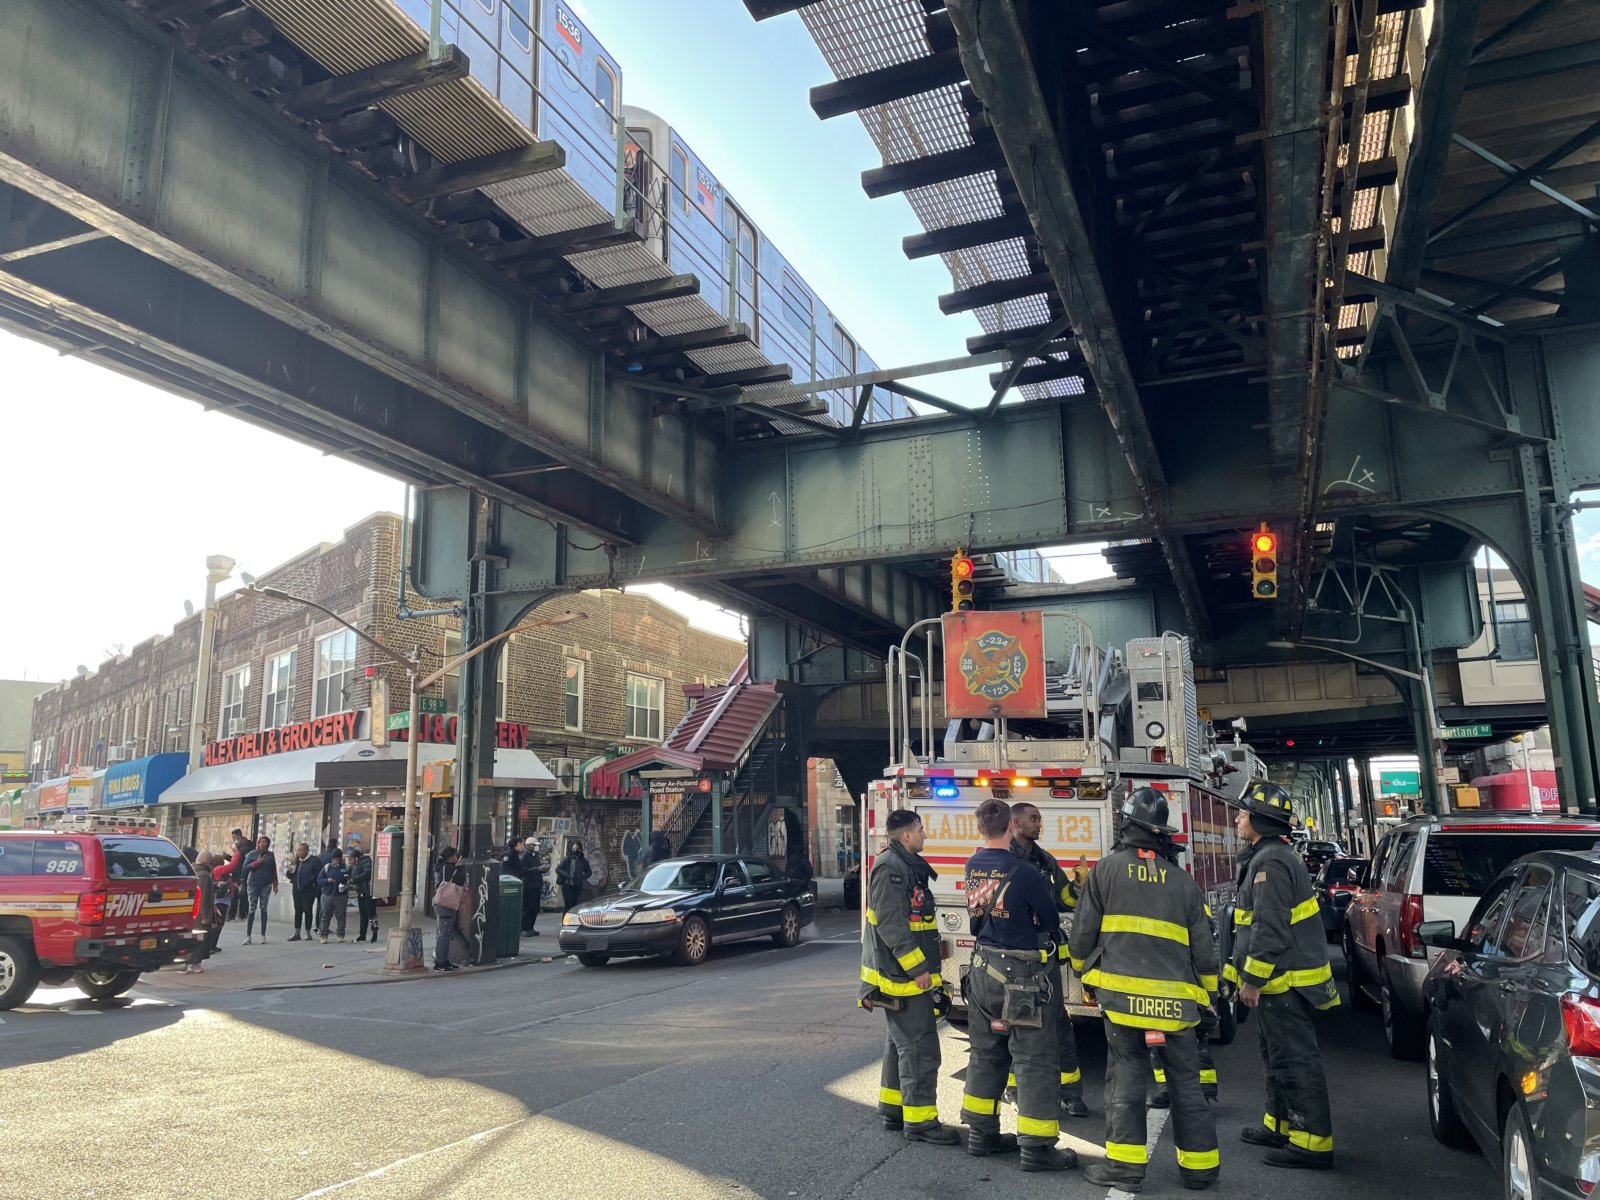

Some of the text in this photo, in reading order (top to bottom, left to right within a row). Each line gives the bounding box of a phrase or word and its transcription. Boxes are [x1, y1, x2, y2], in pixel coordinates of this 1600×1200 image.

[557, 8, 581, 44] 1536
[978, 636, 1009, 648] E-234
[980, 684, 1009, 696] L-123
[422, 698, 426, 710] E
[428, 699, 437, 711] 98
[203, 738, 235, 767] ALEX
[237, 730, 265, 761] DELI
[266, 729, 278, 756] &
[279, 710, 360, 752] GROCERY
[1441, 726, 1478, 738] Rutland
[702, 781, 708, 789] 3
[1056, 815, 1094, 843] 123
[45, 860, 78, 873] 958
[138, 856, 161, 868] 958
[107, 893, 147, 918] FDNY
[1127, 996, 1182, 1019] TORRES
